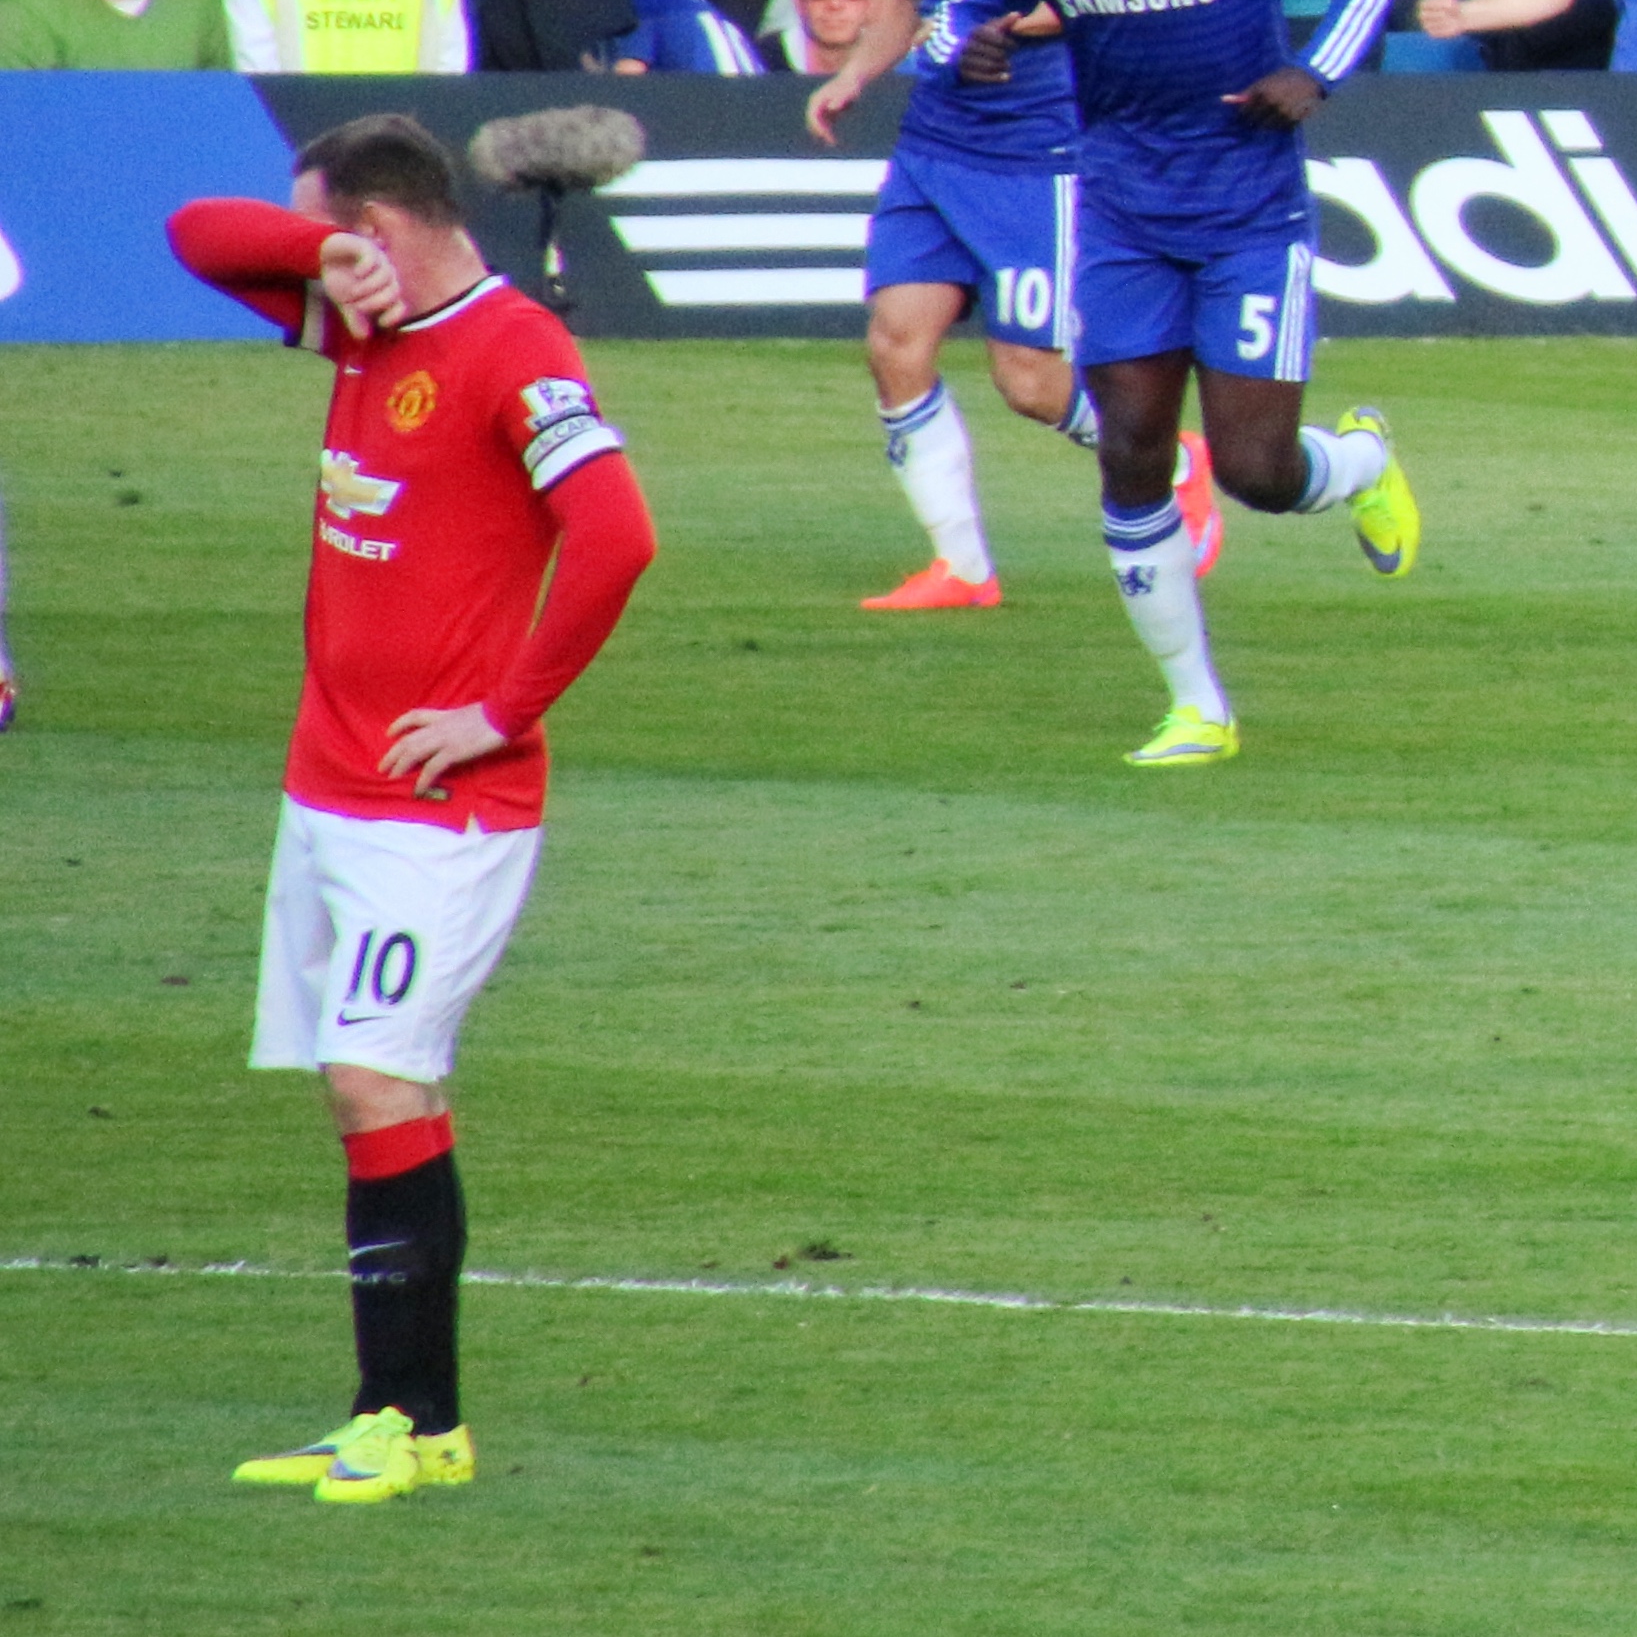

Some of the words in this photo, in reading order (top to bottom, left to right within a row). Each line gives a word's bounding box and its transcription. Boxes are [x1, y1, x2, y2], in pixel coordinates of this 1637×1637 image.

[994, 266, 1052, 330] 10
[1236, 293, 1277, 361] 5
[344, 929, 418, 1005] 10
